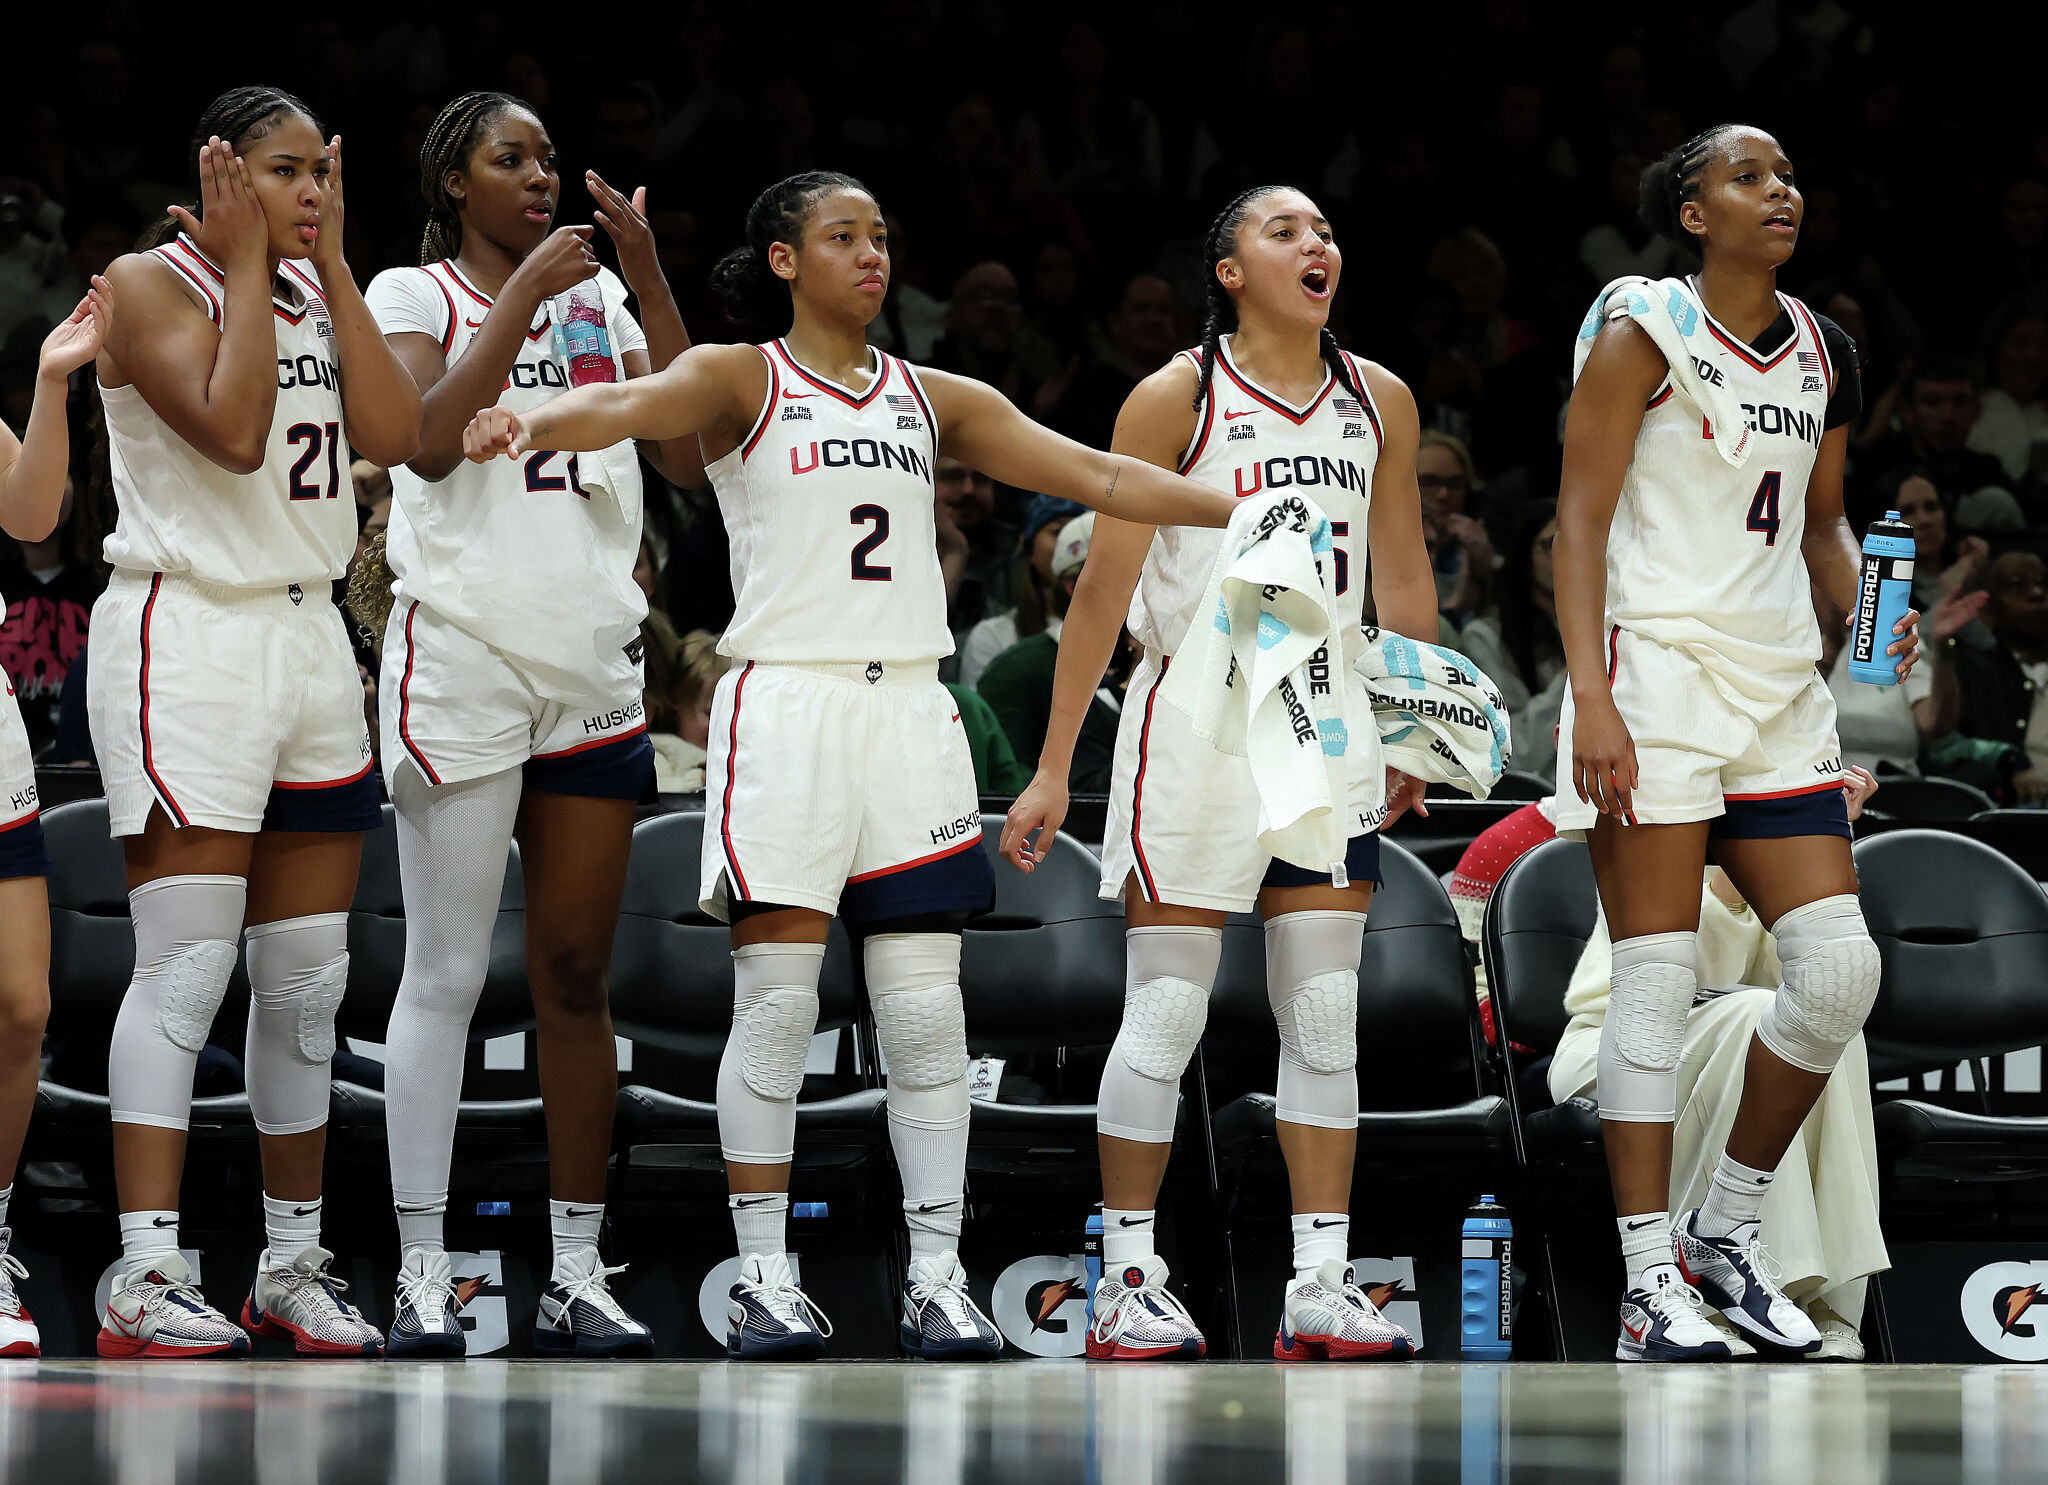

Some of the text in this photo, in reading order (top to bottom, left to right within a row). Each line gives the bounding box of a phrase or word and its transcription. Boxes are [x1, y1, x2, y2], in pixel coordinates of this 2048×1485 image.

[1804, 376, 1819, 384] BIG
[1802, 383, 1824, 391] EAST
[784, 406, 811, 414] BE THE
[781, 412, 813, 422] CHANGE
[897, 415, 916, 424] BIG
[896, 421, 923, 430] EAST
[1229, 424, 1255, 434] BE THE
[1344, 422, 1361, 431] BIG
[1227, 432, 1256, 441] CHANGE
[1342, 429, 1368, 437] EAST
[286, 421, 340, 501] 21
[789, 438, 931, 485] UCONN
[1234, 455, 1366, 499] UCONN
[1746, 470, 1782, 547] 4
[849, 503, 893, 581] 2
[583, 701, 643, 735] HUSKIES
[991, 1253, 1090, 1358] G
